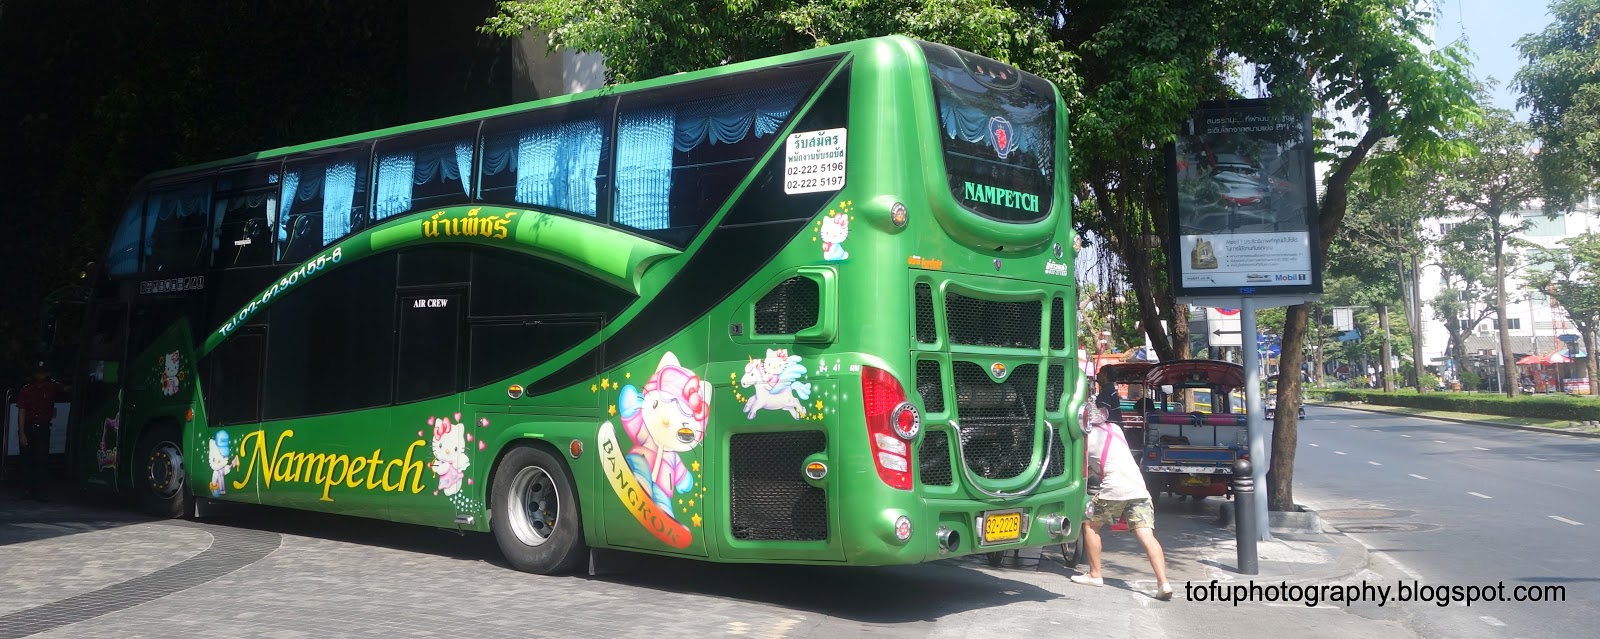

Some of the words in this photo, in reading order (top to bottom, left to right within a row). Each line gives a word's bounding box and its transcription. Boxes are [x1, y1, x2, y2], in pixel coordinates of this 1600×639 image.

[794, 131, 839, 149] รับสมัคร
[788, 147, 844, 162] พนักงานขับรถบัส
[787, 164, 818, 176] 02-222
[820, 161, 843, 172] 5196
[786, 178, 817, 189] 02-222
[820, 176, 843, 187] 5197
[964, 181, 1039, 213] NAMPETCH
[413, 299, 426, 308] AIR
[427, 298, 449, 308] CREW
[233, 429, 427, 502] Nampetch
[602, 438, 681, 545] BANGKOK
[986, 516, 1018, 534] 32-2228
